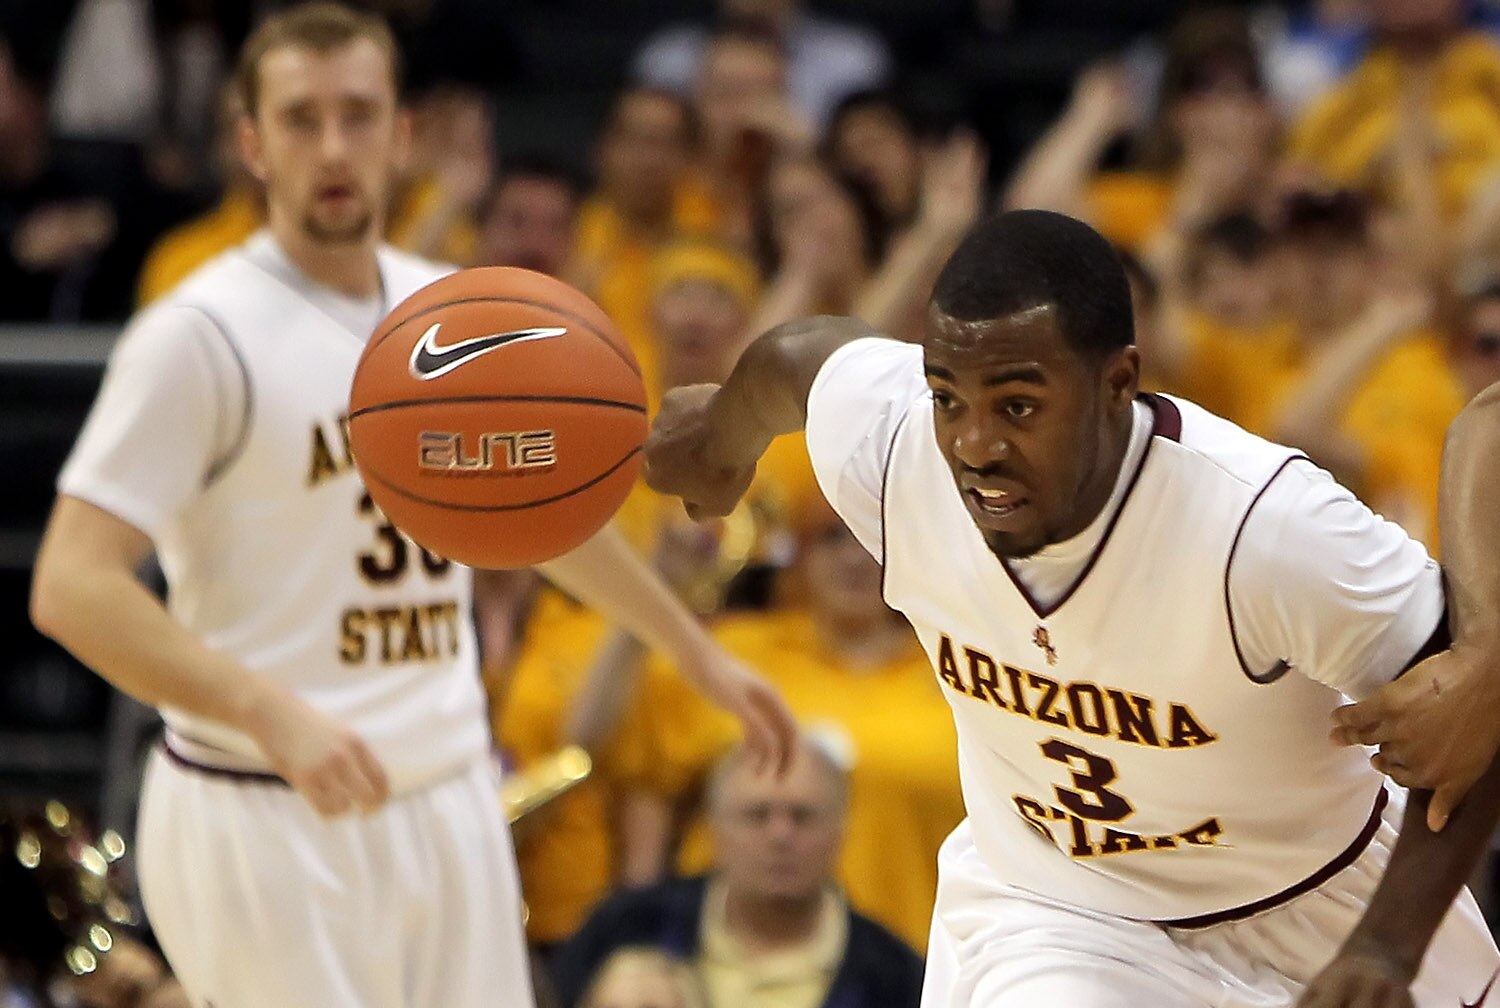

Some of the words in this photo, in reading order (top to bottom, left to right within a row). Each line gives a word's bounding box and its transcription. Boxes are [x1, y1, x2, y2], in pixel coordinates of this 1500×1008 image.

[418, 430, 557, 471] ELITE
[938, 632, 1219, 749] ARIZONA
[1036, 735, 1135, 823] 3
